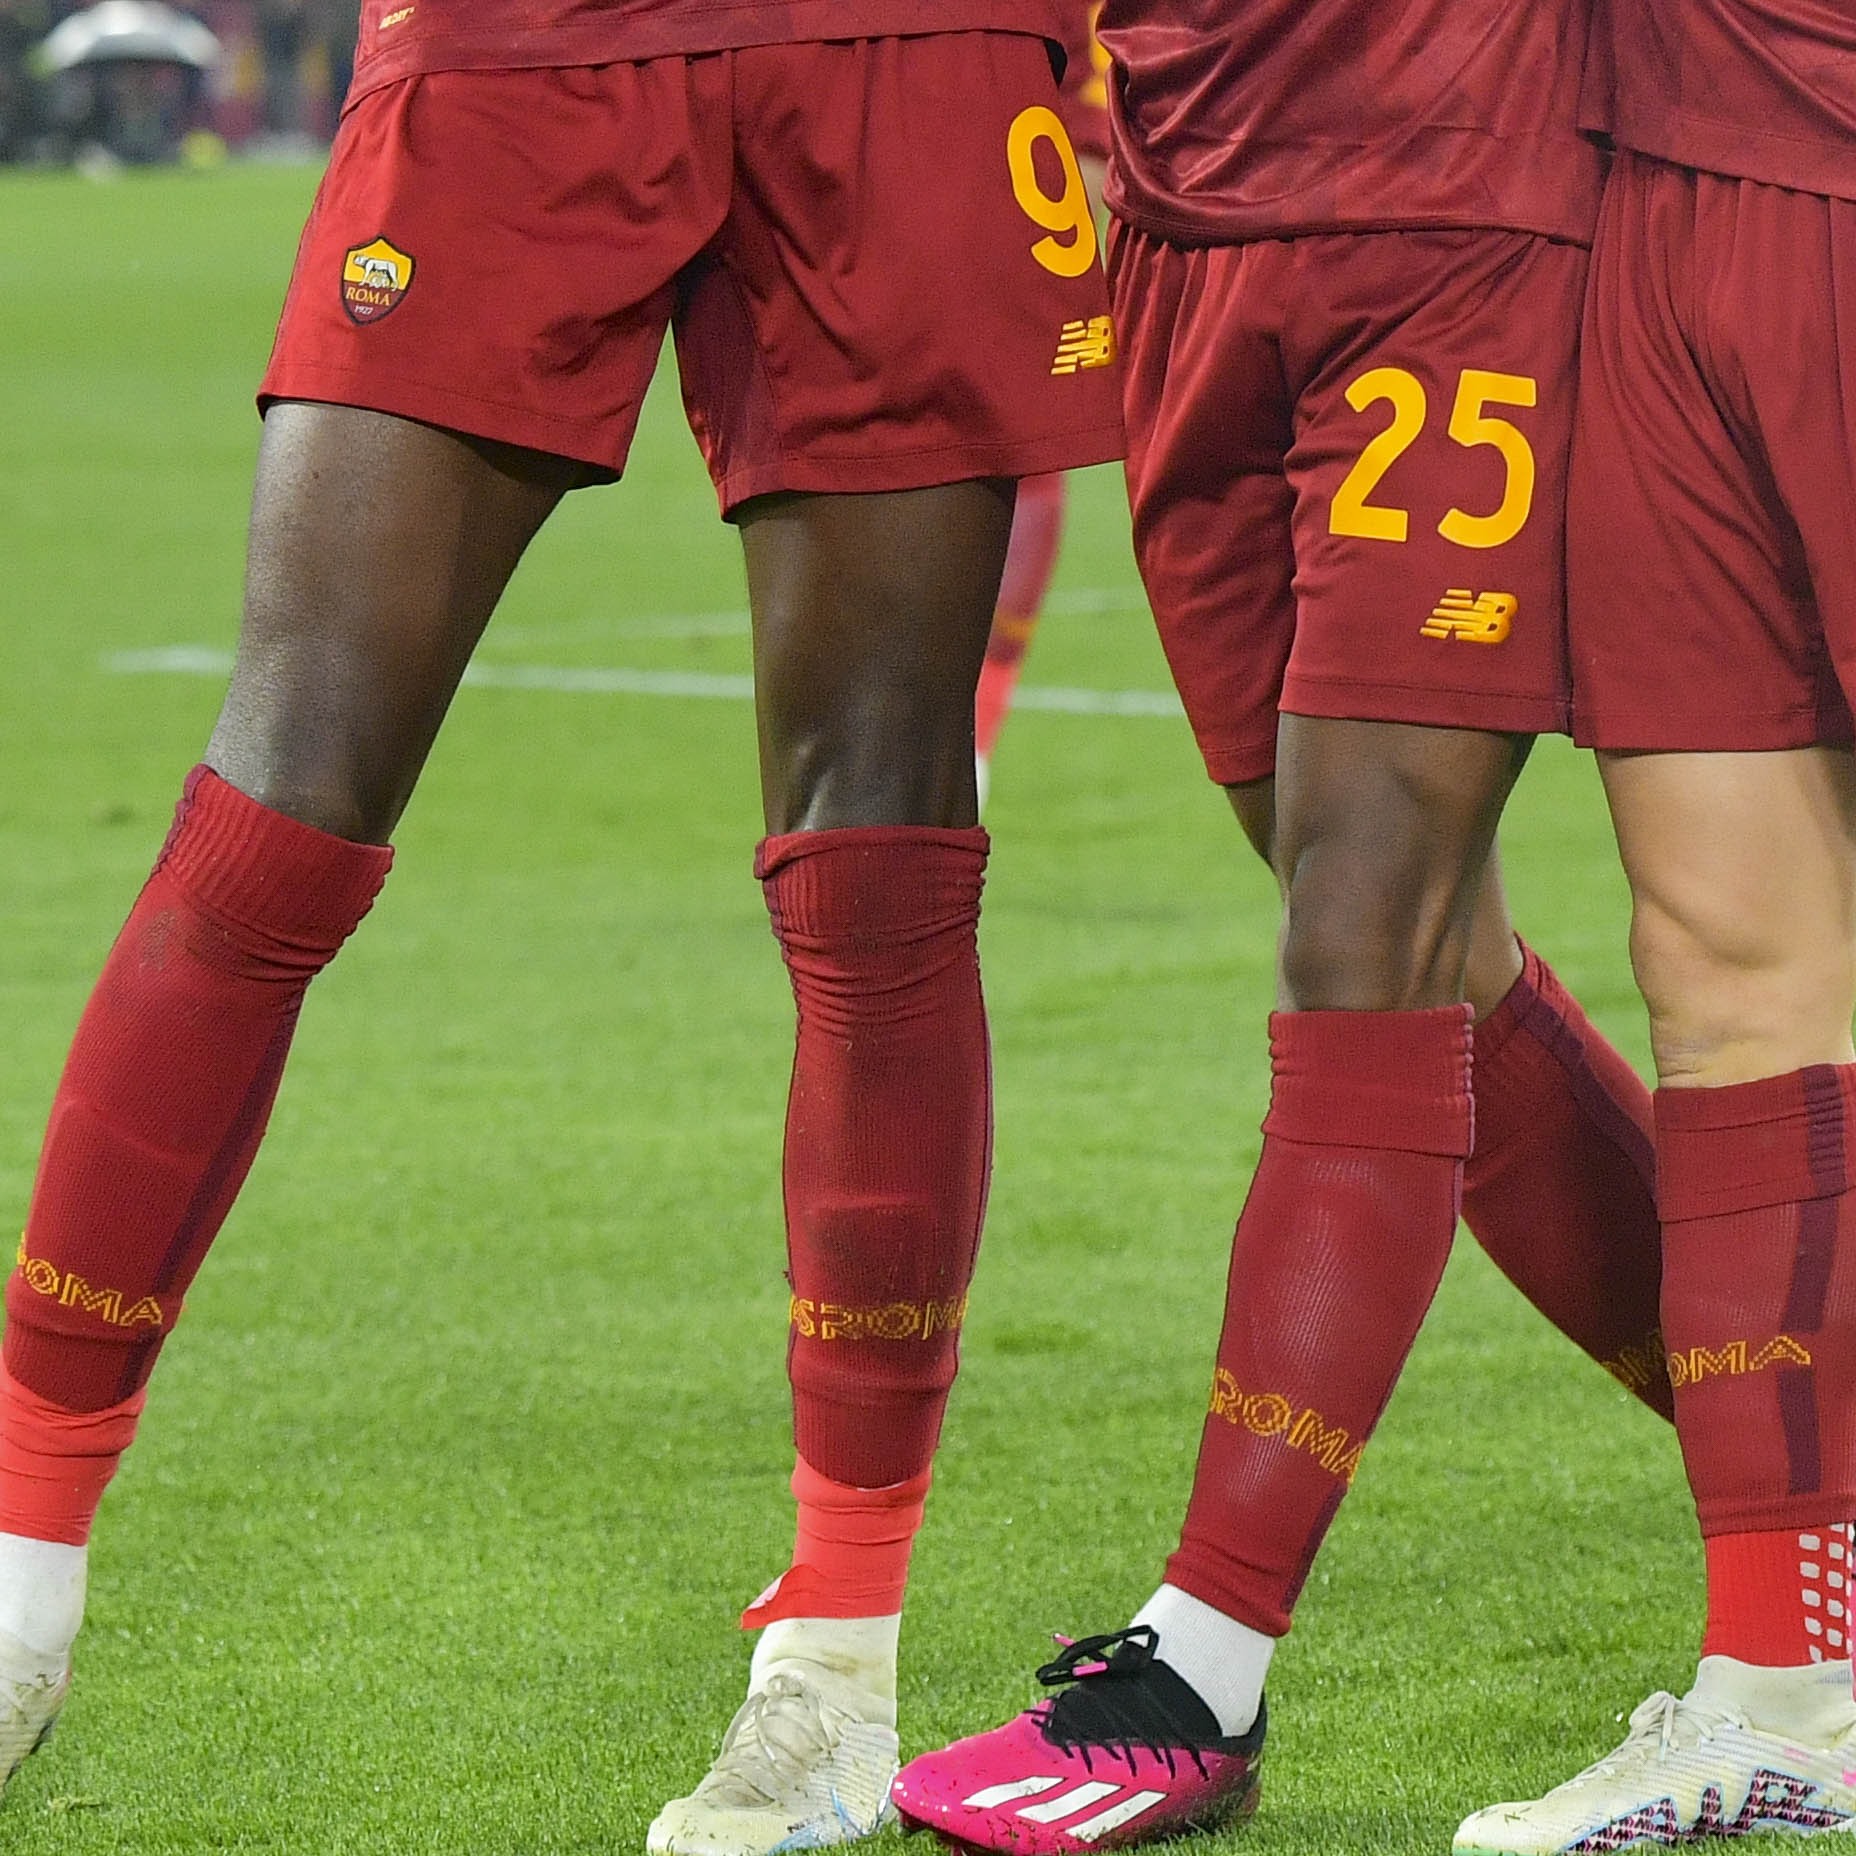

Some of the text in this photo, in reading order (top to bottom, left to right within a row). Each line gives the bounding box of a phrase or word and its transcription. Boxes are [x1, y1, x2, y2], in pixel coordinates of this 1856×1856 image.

[1005, 105, 1098, 278] 9
[345, 286, 392, 306] ROMA
[1328, 366, 1538, 550] 25
[17, 1231, 163, 1326] OMA
[1667, 1334, 1812, 1388] OMA
